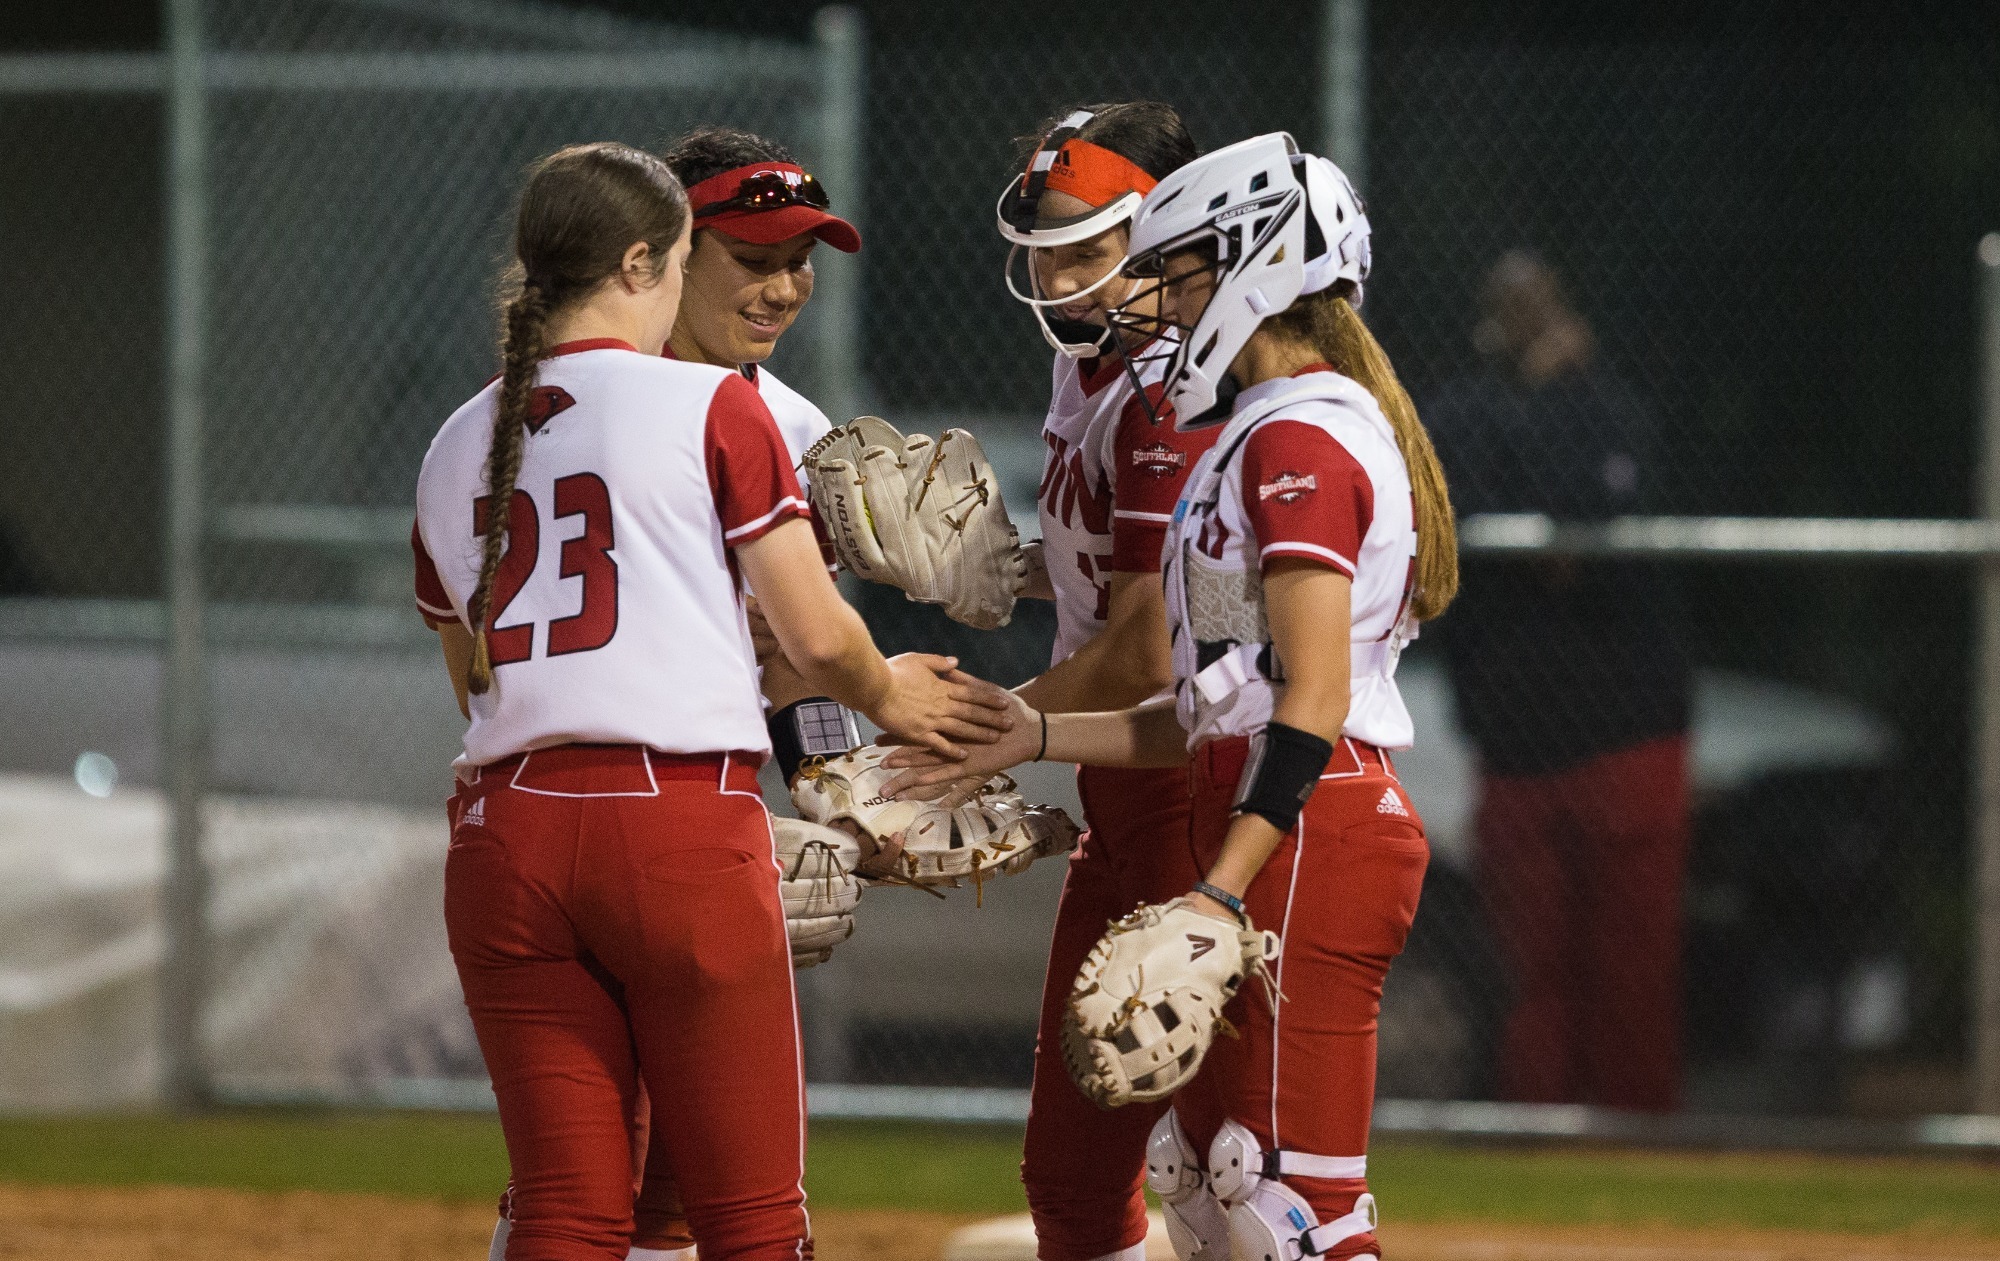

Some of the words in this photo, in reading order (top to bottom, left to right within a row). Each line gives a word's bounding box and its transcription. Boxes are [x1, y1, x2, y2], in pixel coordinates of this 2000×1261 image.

[1215, 203, 1260, 222] EASTON
[1132, 450, 1187, 467] SOUTHLAND
[1259, 474, 1316, 500] SOUTHLAND
[835, 493, 872, 571] EASTON
[467, 472, 618, 667] 23
[1376, 803, 1409, 817] adidas
